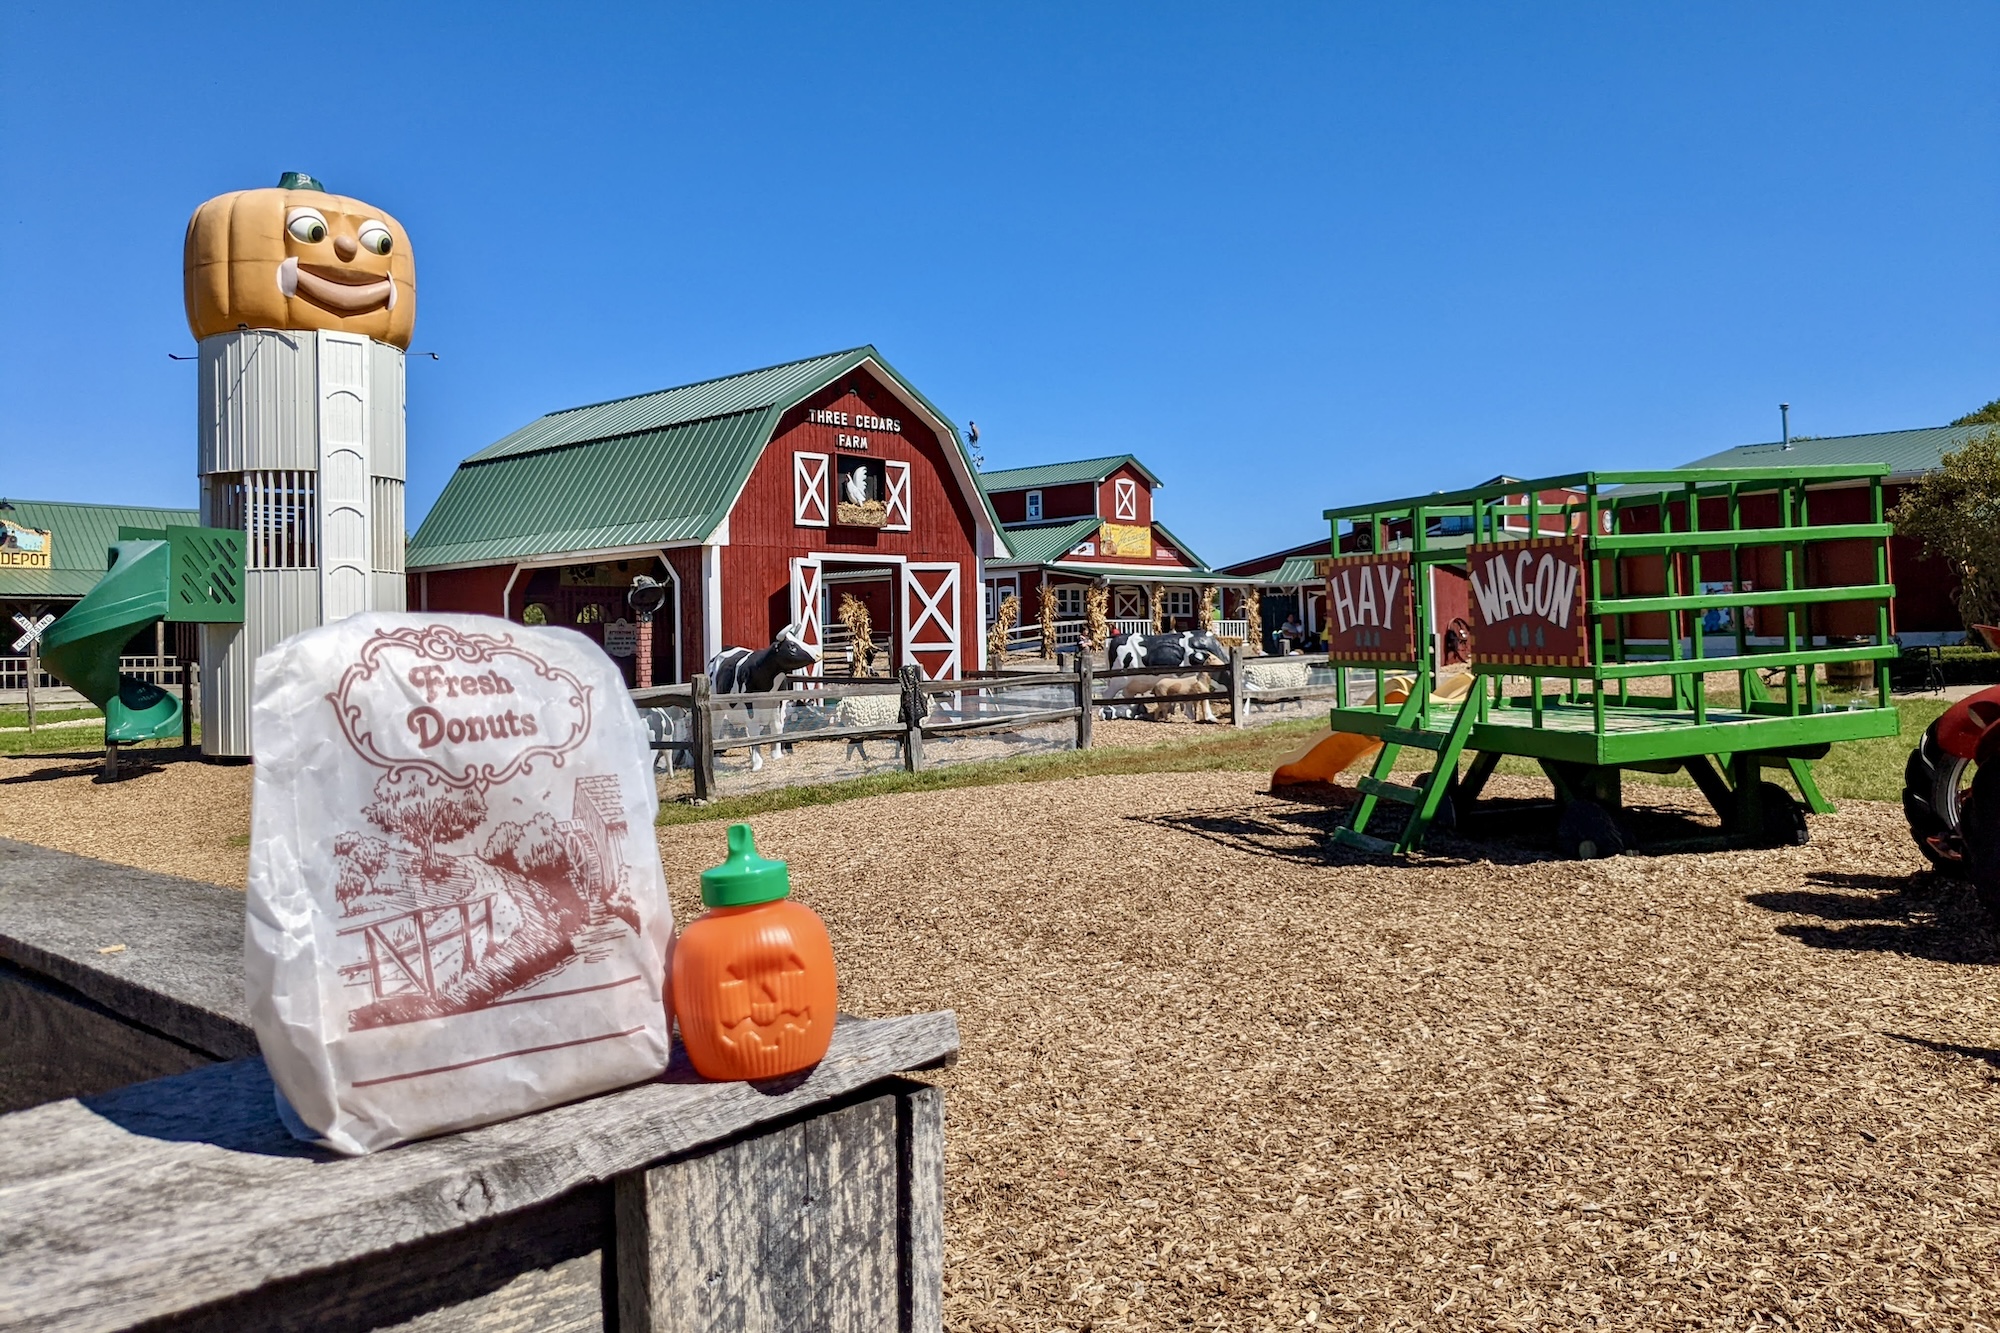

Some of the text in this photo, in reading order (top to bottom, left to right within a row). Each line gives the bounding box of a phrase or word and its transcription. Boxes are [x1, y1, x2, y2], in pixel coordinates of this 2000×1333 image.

[809, 409, 901, 432] THREE CEDARS
[838, 434, 868, 449] FARM
[0, 552, 48, 566] DEPOT
[1330, 565, 1400, 633] HAY
[1469, 550, 1578, 629] WAGON
[15, 615, 52, 649] CROSSING
[408, 664, 515, 703] Fresh
[407, 705, 538, 749] Donuts
